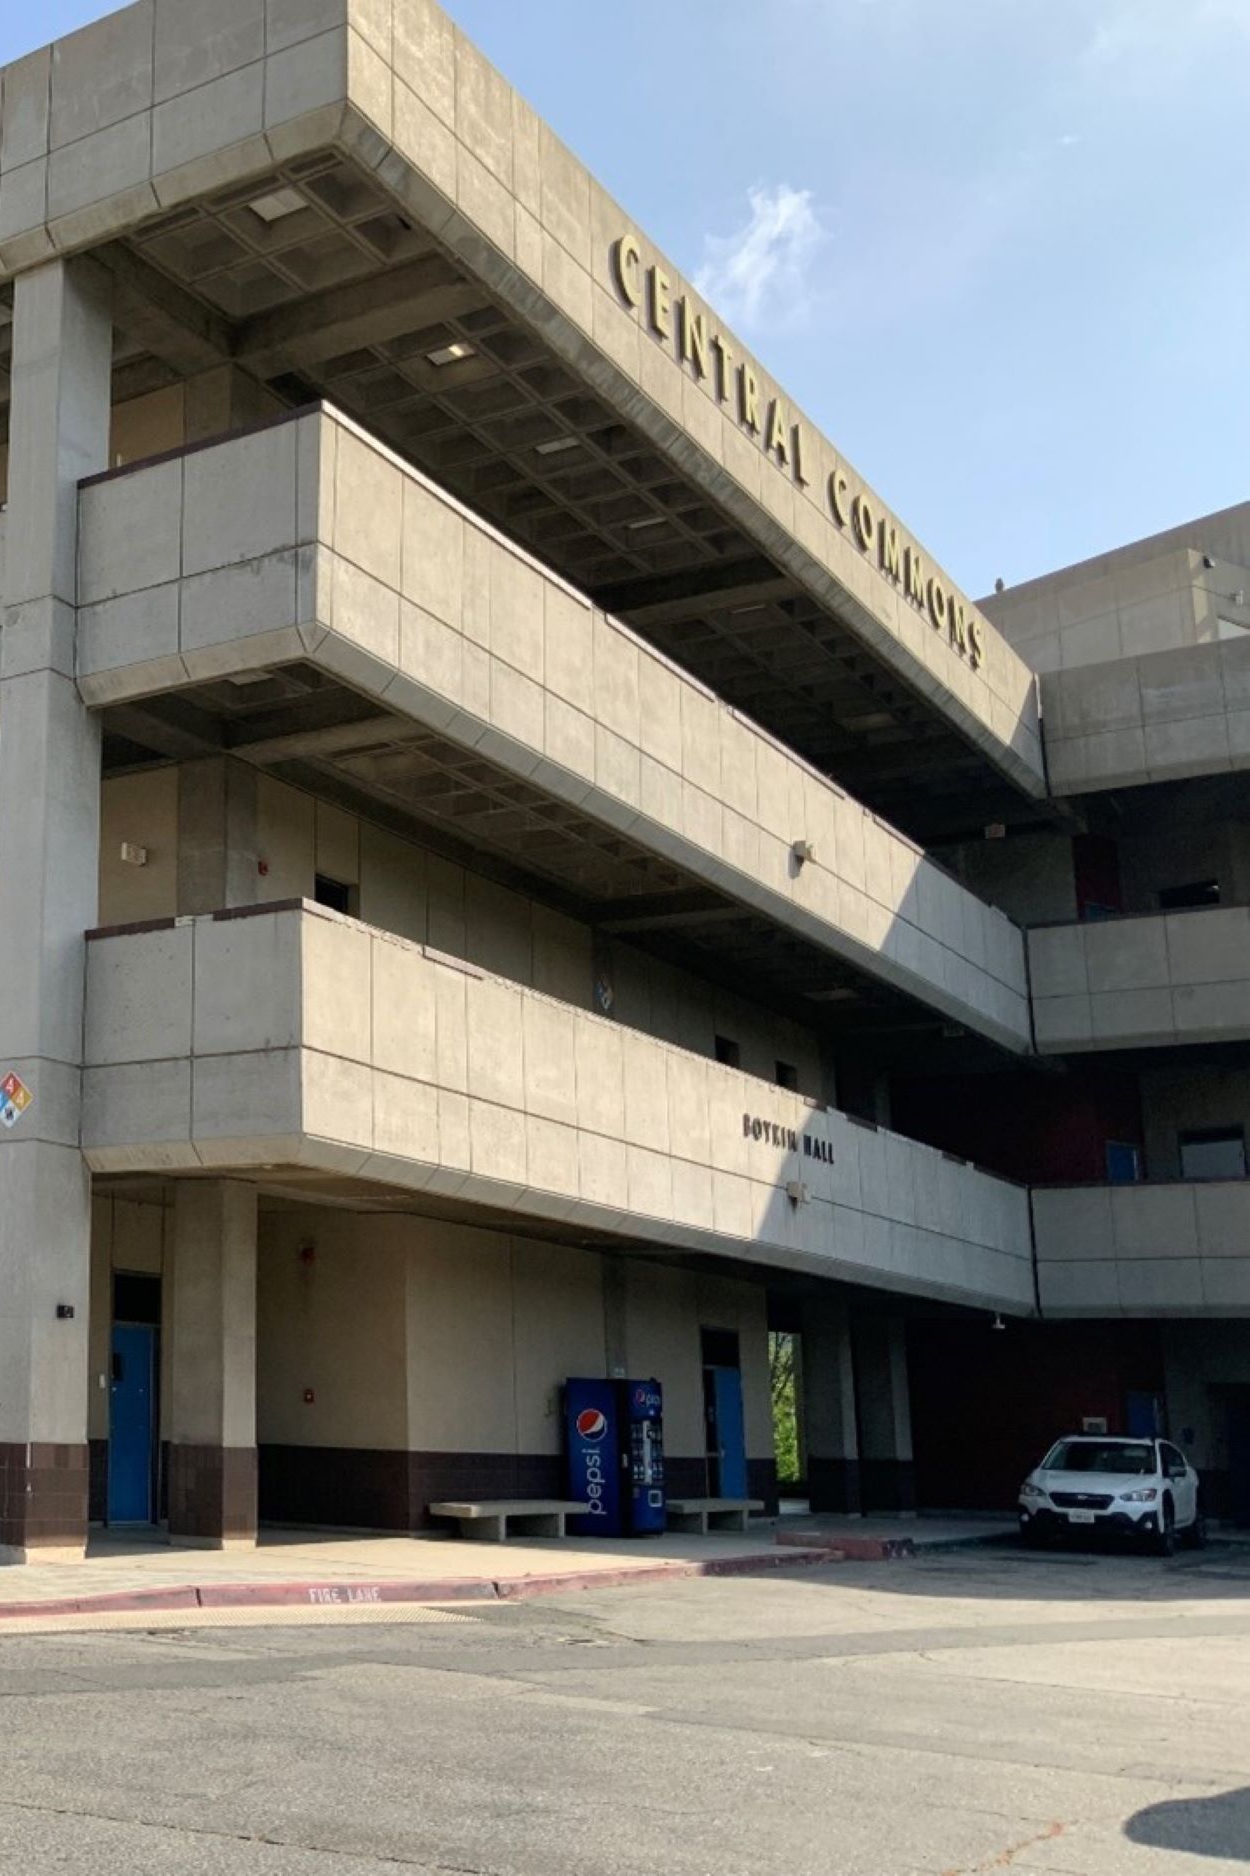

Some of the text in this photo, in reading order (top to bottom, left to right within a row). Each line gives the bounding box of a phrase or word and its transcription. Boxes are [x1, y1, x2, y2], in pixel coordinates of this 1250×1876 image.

[610, 233, 985, 670] CENTRAL COMMONS
[742, 1112, 834, 1165] BOYKIN HALL
[582, 1448, 607, 1515] pepsi
[308, 1586, 381, 1603] FIRE LANE
